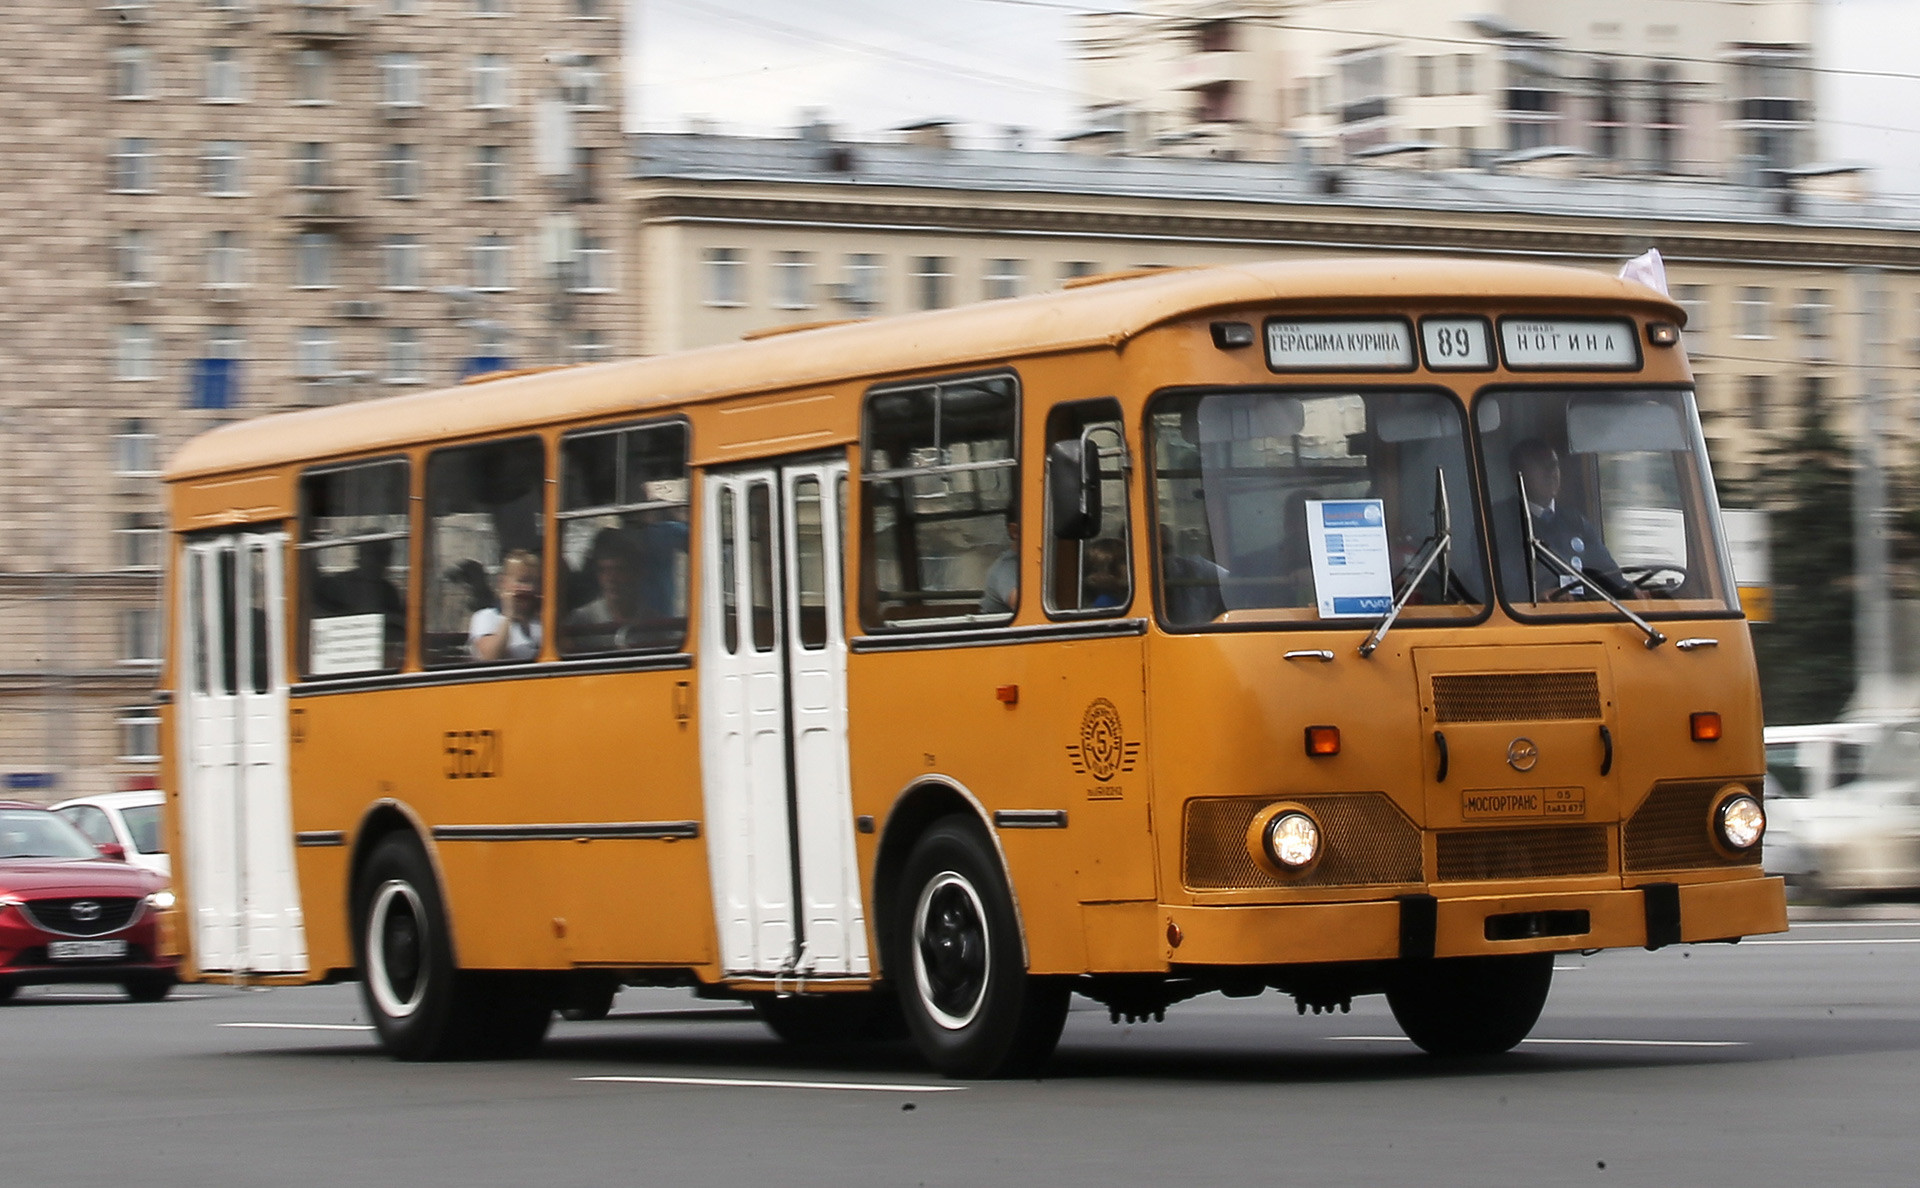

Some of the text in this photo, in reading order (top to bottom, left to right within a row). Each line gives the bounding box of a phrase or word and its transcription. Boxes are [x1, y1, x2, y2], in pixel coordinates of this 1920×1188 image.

[1271, 332, 1400, 352] ГЕРАСИМА КУРИНА
[1438, 328, 1470, 357] 89
[1517, 333, 1614, 351] НОГИНА
[1097, 731, 1107, 755] 5
[1468, 795, 1538, 812] МОСГОРТРАНС
